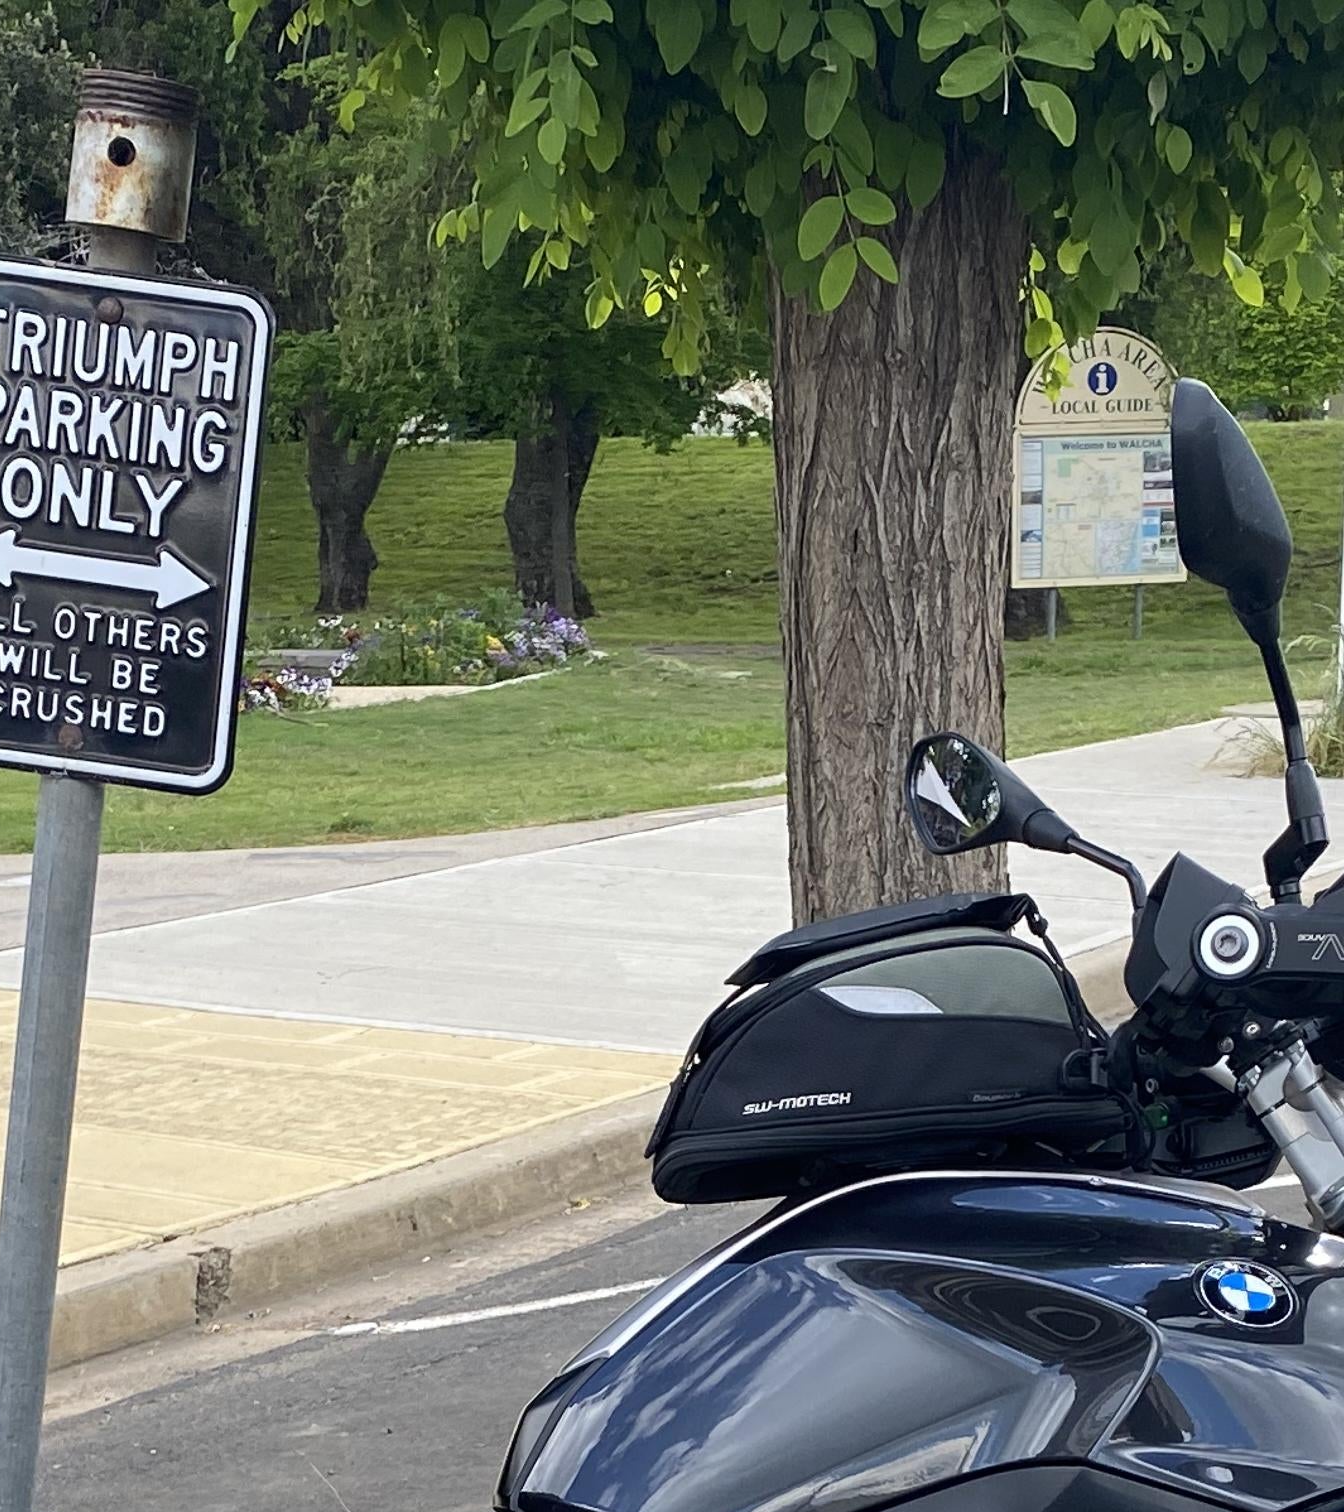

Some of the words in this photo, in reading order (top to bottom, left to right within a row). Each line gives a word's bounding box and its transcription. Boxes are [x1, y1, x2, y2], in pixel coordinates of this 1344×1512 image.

[1117, 341, 1168, 392] AREA
[1052, 400, 1099, 414] LOCAL
[1105, 398, 1153, 413] GUIDE
[1060, 441, 1104, 450] Welcome
[1106, 441, 1116, 449] to
[1119, 439, 1163, 449] WALCHA
[1, 457, 183, 538] ONLY
[54, 608, 208, 659] OTHERS
[112, 660, 160, 694] BE
[742, 1092, 852, 1115] SW-MOTECH
